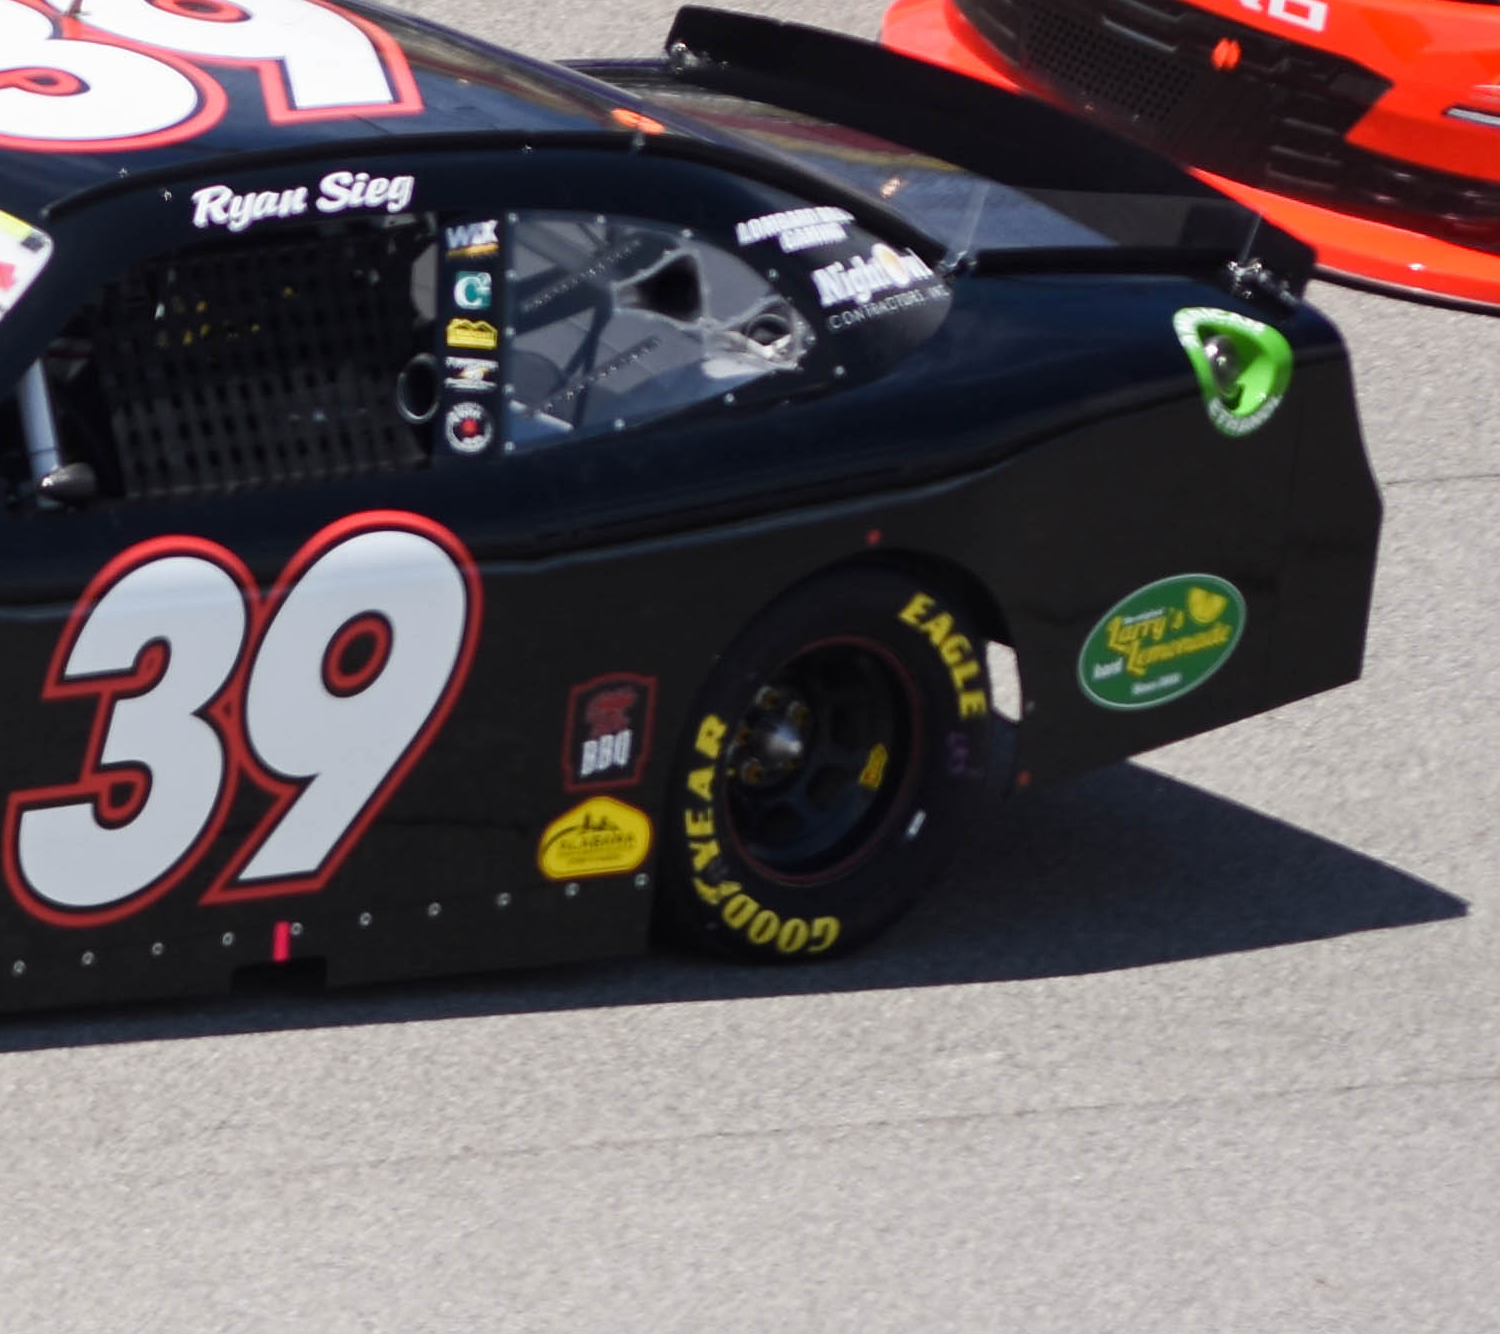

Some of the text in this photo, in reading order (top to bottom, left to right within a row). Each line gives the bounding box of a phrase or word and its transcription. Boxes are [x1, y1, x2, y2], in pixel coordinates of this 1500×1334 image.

[191, 171, 416, 233] Ryan Sieg
[2, 508, 485, 929] 39
[898, 591, 990, 723] EAGLE
[684, 712, 843, 955] GOODYEAR
